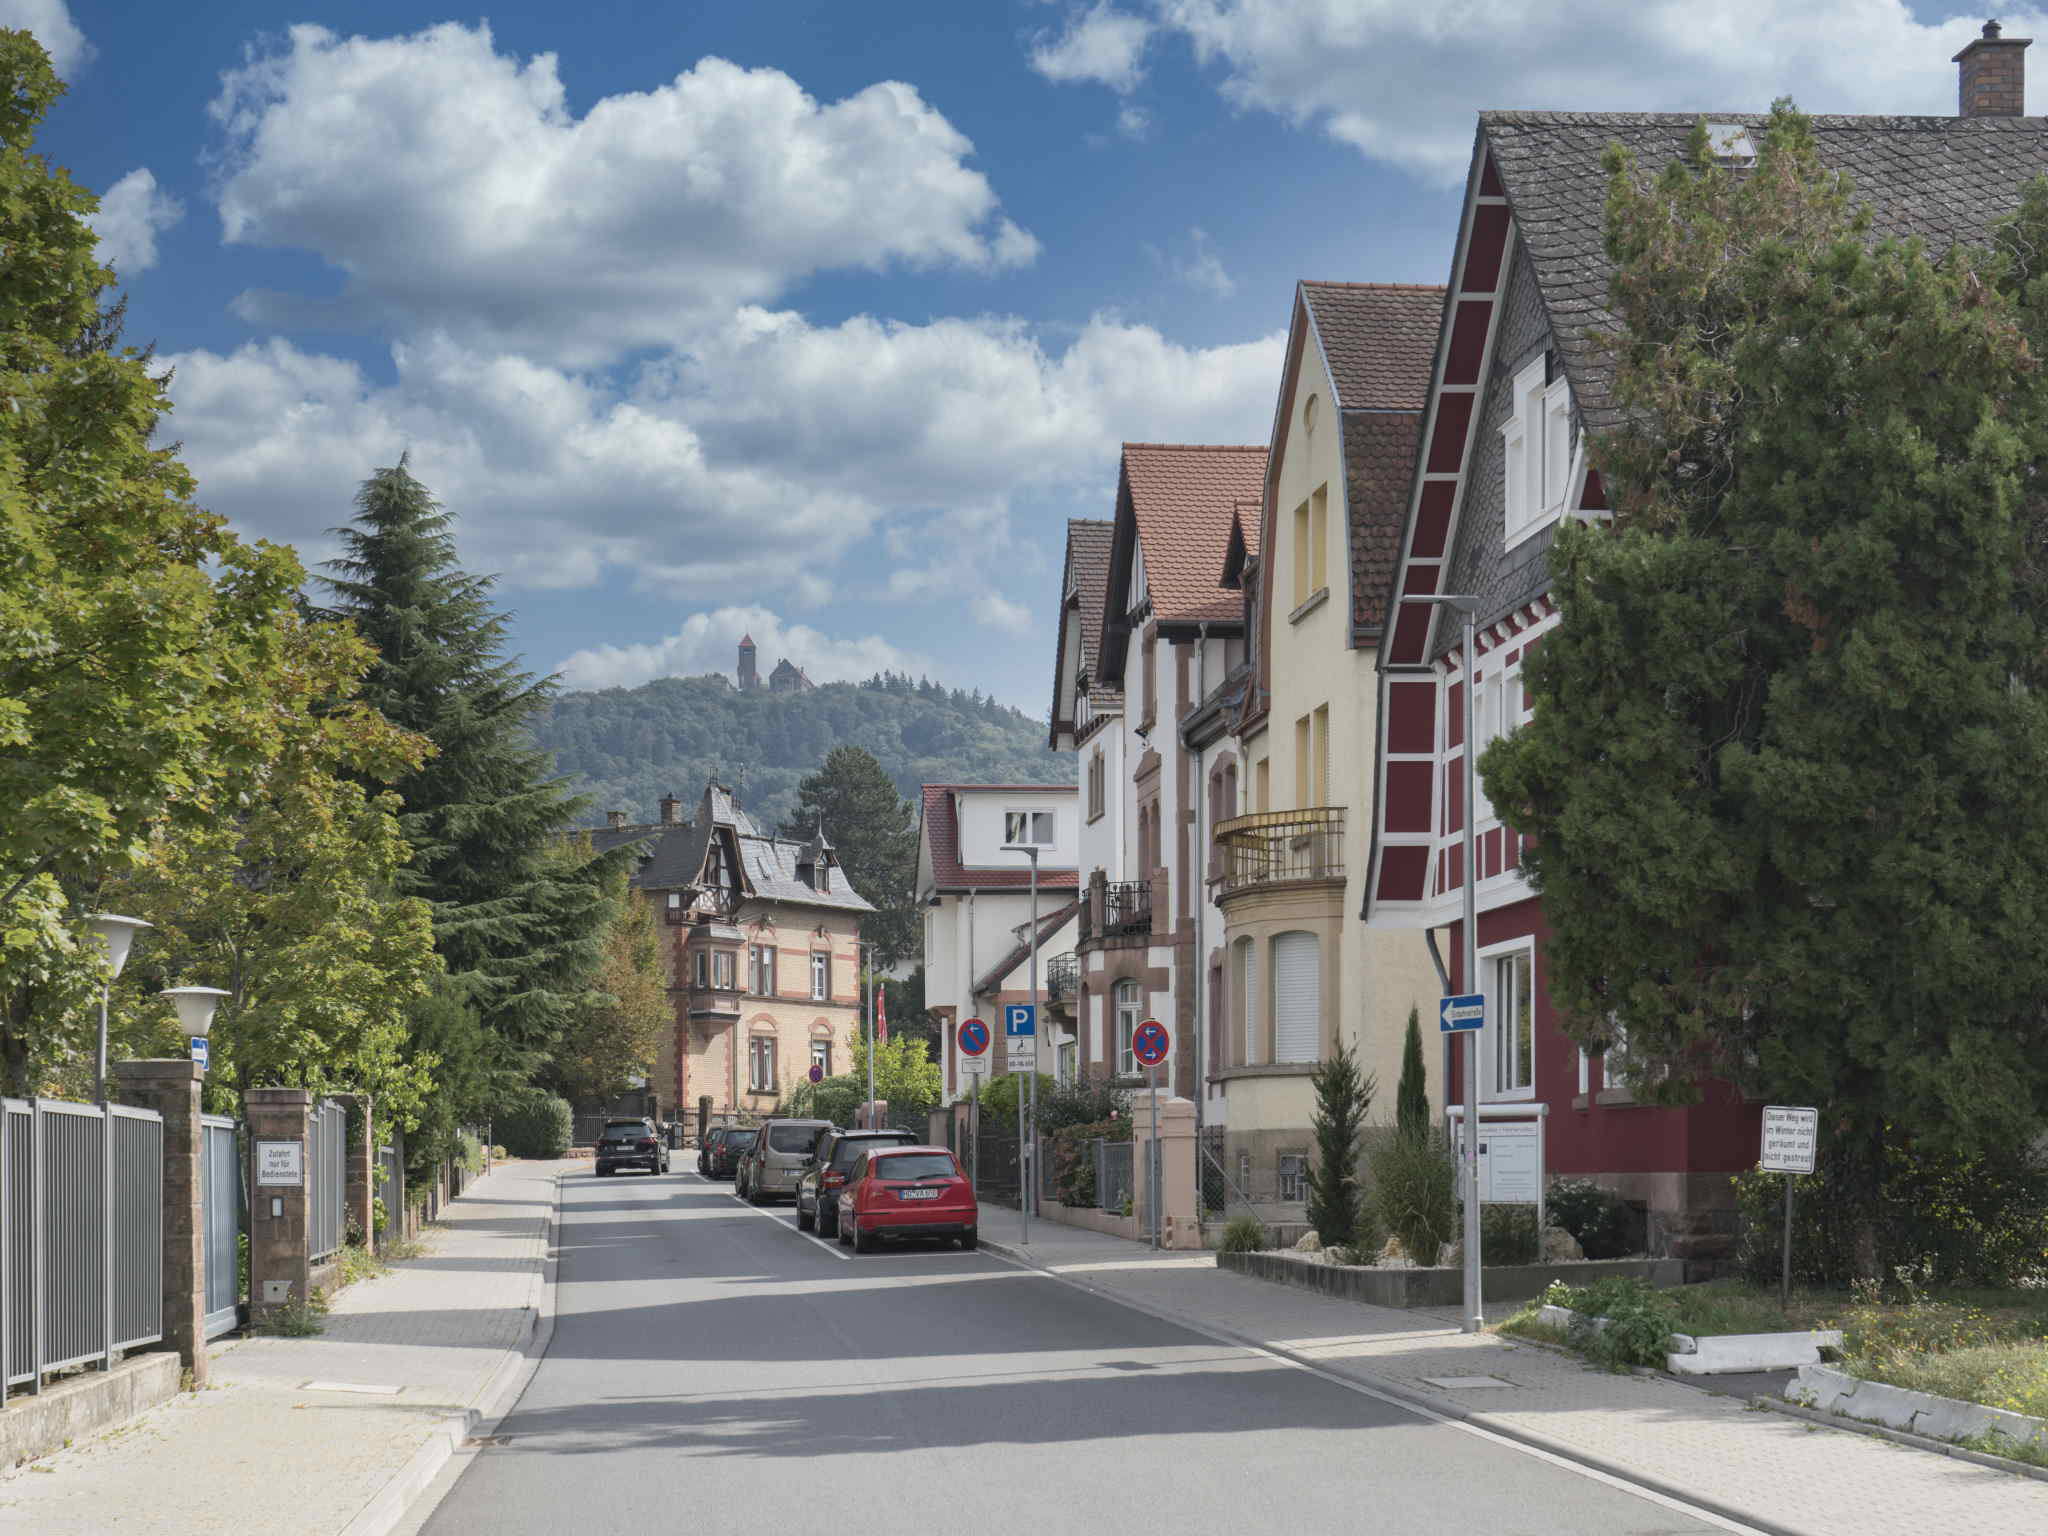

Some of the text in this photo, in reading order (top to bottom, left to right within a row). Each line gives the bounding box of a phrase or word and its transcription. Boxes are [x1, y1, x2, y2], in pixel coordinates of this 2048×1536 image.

[1012, 1009, 1028, 1032] P
[1767, 1111, 1814, 1124] Dieser Weg wird
[1766, 1126, 1813, 1136] im Winter nicht
[1768, 1140, 1809, 1150] geräumt und
[267, 1149, 290, 1158] Zufahrt
[1764, 1152, 1811, 1164] nicht gestreut
[280, 1159, 289, 1168] für
